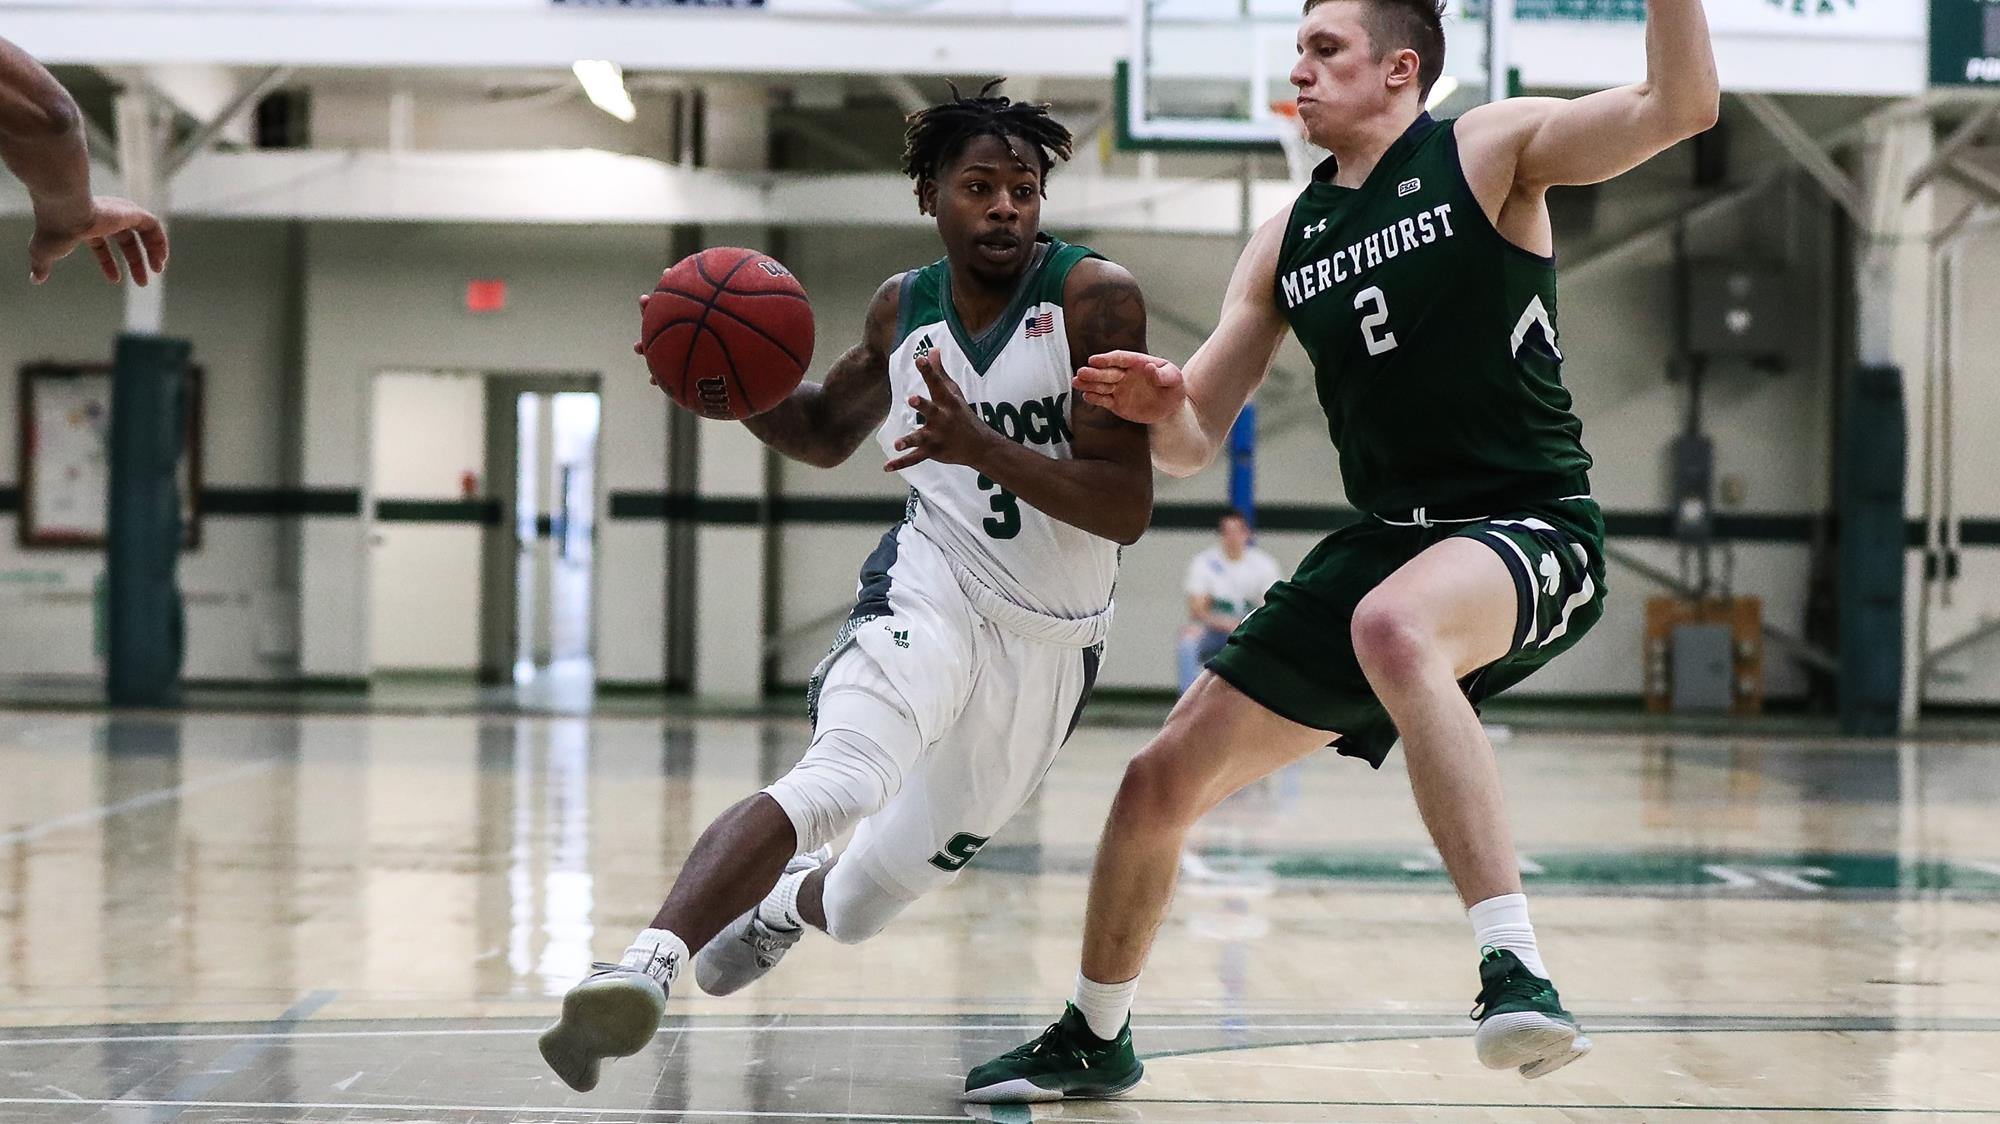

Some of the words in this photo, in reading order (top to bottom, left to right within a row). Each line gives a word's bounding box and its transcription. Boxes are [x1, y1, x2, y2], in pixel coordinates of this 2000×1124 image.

[1281, 203, 1454, 309] MERCYHURST
[1354, 285, 1398, 357] 2
[977, 472, 1021, 539] 3
